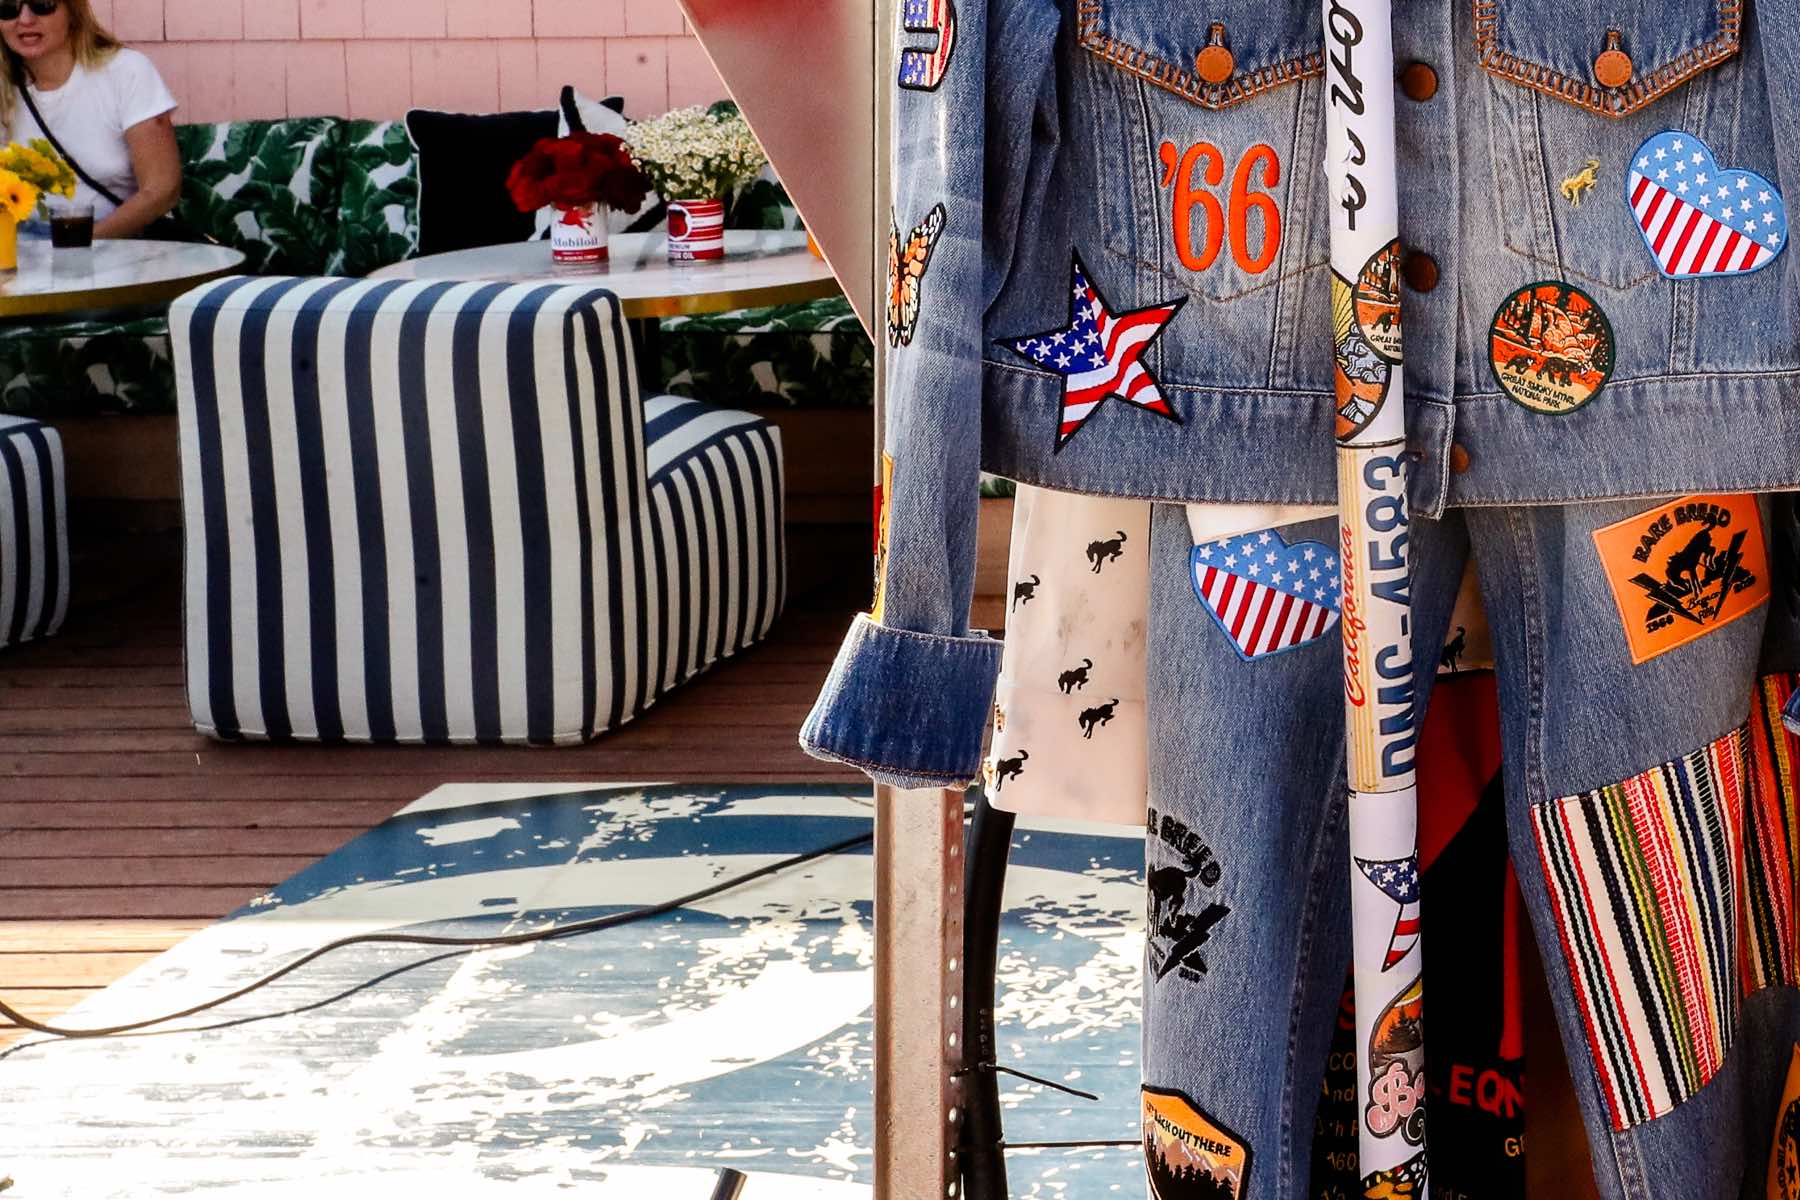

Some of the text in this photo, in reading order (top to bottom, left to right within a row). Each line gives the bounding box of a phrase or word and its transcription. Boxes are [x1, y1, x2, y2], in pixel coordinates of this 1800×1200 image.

[552, 237, 599, 248] Mobiloil
[1501, 372, 1526, 388] GREAT
[1632, 503, 1732, 563] RARE BREED
[1340, 524, 1367, 707] California
[1171, 1125, 1233, 1158] OUT THERE
